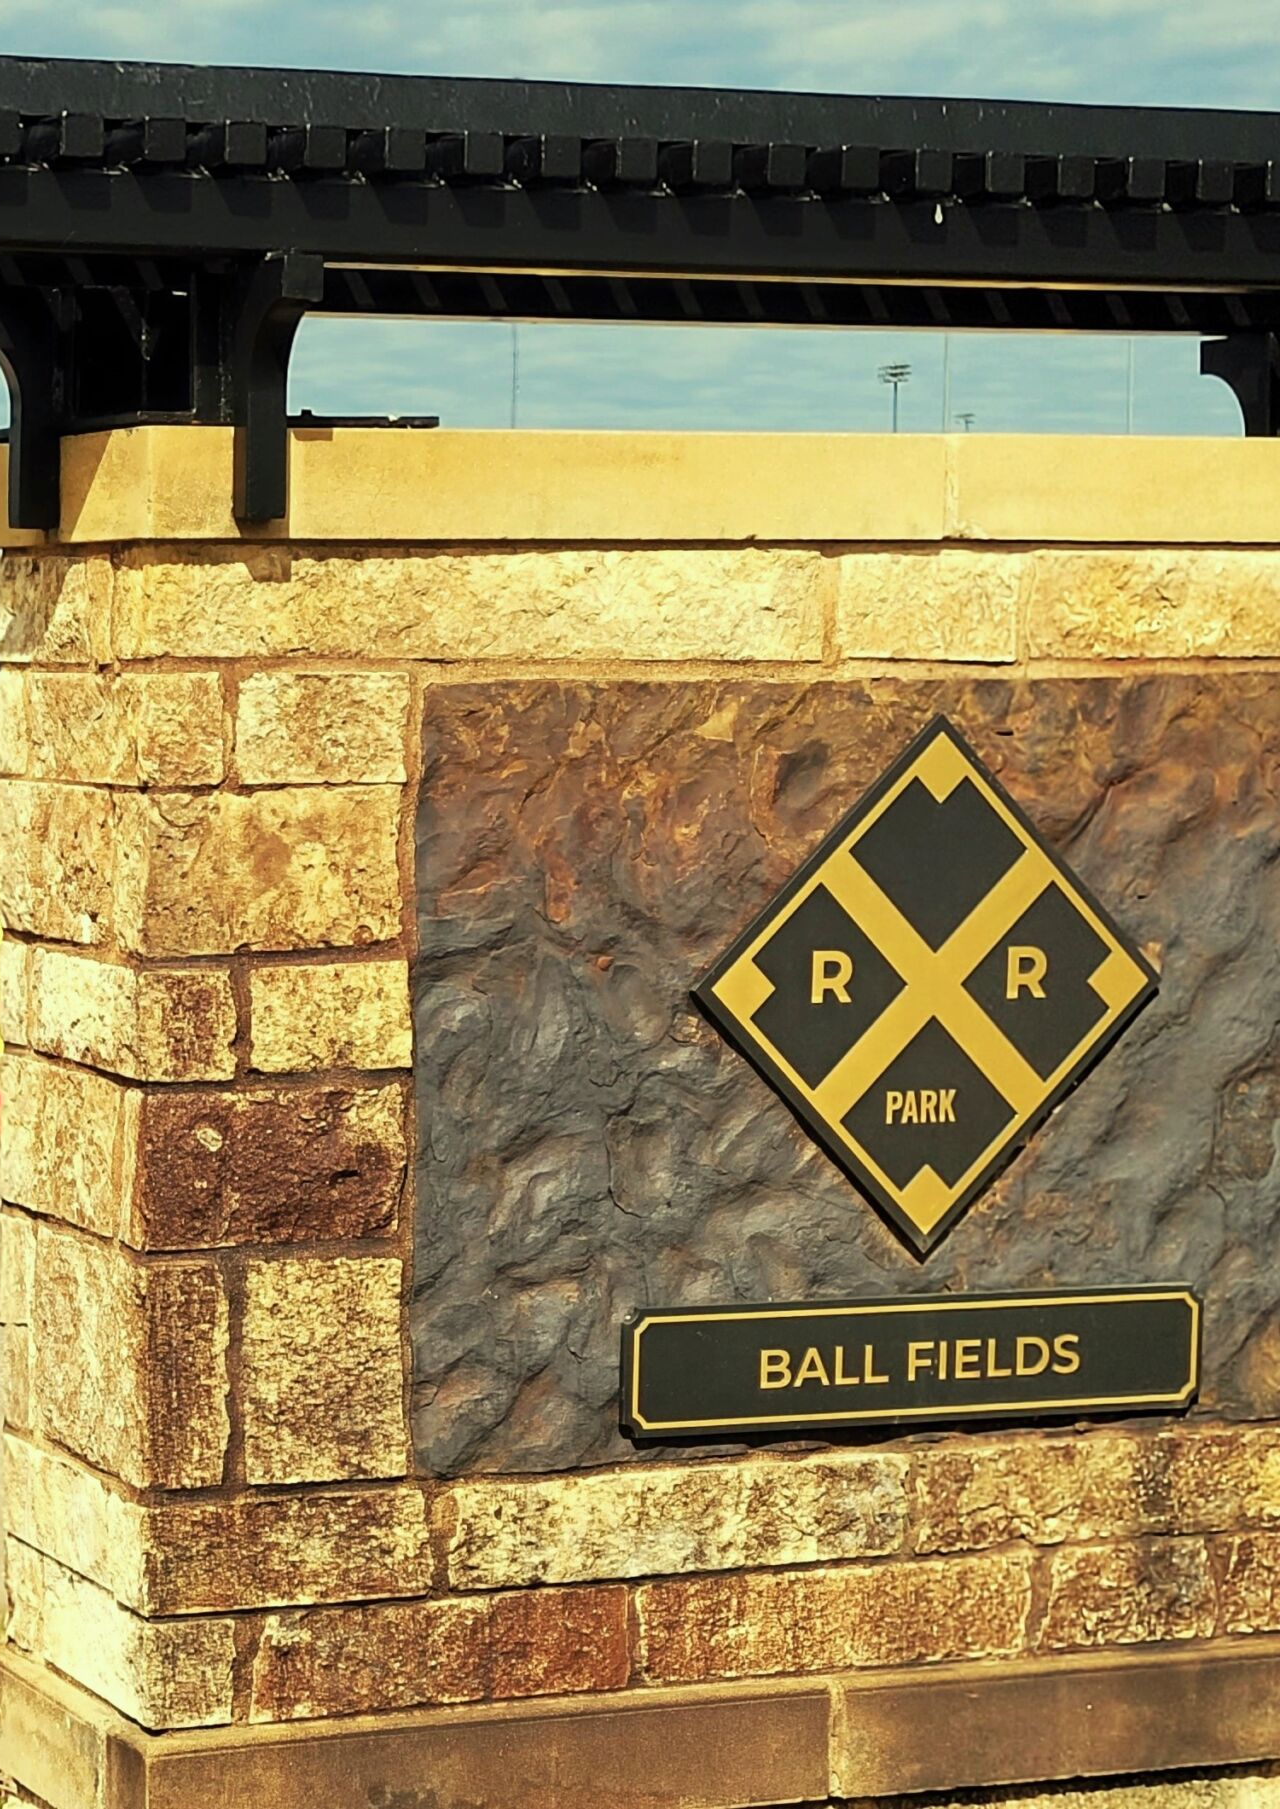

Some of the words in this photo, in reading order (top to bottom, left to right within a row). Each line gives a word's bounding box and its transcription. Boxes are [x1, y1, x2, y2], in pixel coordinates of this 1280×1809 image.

[811, 950, 854, 1004] R
[1005, 946, 1048, 1000] R
[886, 1089, 957, 1125] PARK
[759, 1345, 890, 1389] BALL
[907, 1334, 1081, 1382] FIELDS
